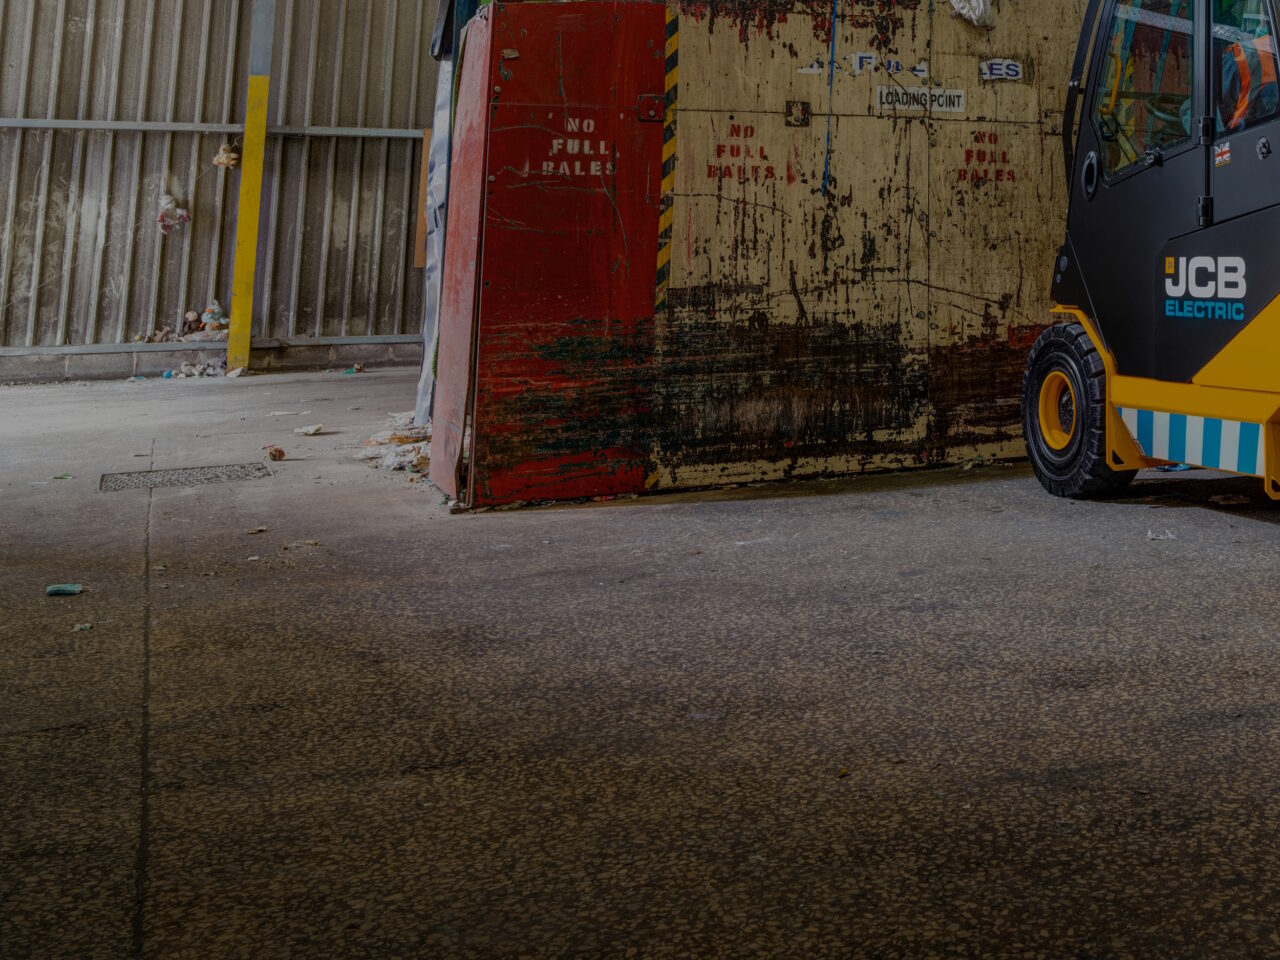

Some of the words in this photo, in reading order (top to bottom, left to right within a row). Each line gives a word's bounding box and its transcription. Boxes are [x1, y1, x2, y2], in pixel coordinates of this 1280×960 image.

[879, 90, 927, 107] LOADING
[931, 93, 962, 108] POINT
[567, 117, 595, 133] NO
[730, 123, 754, 139] NO
[975, 131, 998, 145] NO
[552, 139, 609, 155] FULL
[716, 144, 767, 159] FULL
[965, 149, 1010, 164] FULL
[542, 160, 617, 176] BALES
[1165, 256, 1247, 298] JCB
[1165, 299, 1245, 320] ELECTRIC
